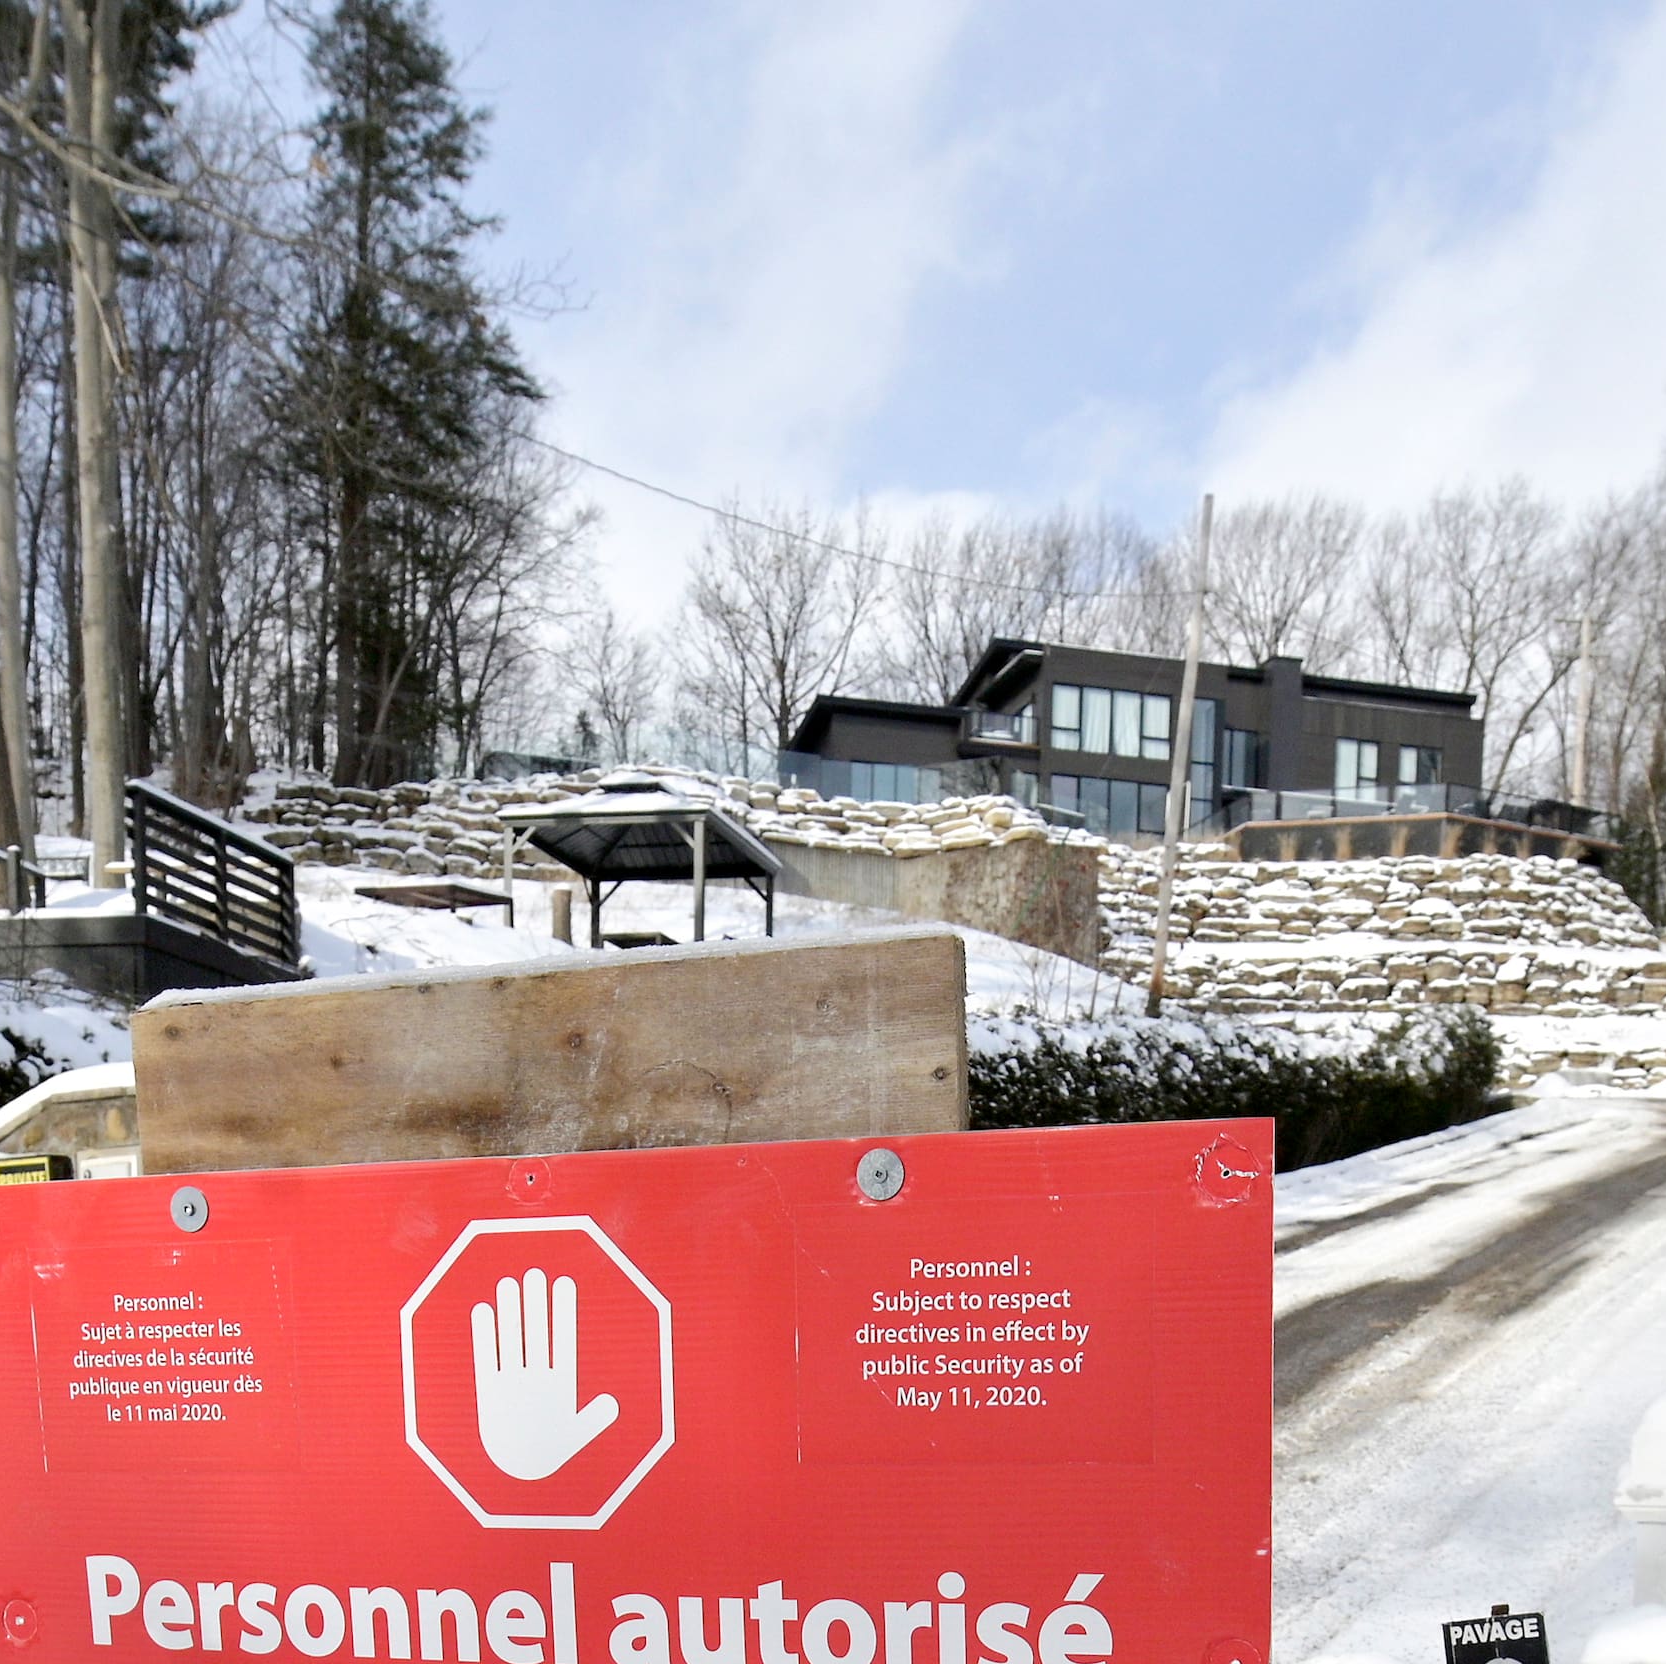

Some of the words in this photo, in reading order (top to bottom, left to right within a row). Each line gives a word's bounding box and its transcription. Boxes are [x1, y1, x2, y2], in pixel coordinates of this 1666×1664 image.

[910, 1254, 1019, 1279] Personnel
[113, 1290, 195, 1312] Personnel
[872, 1290, 954, 1316] Subject
[958, 1291, 983, 1310] to
[988, 1289, 1071, 1314] respect
[80, 1322, 122, 1345] Sujet
[125, 1321, 135, 1340] à
[138, 1321, 215, 1344] respecter
[218, 1318, 242, 1337] les
[855, 1322, 960, 1344] directives
[966, 1321, 986, 1342] in
[992, 1319, 1056, 1342] effect
[1061, 1319, 1090, 1346] by
[73, 1349, 143, 1369] direcives
[146, 1348, 167, 1367] de
[170, 1347, 185, 1367] la
[188, 1346, 254, 1366] sécurité
[862, 1354, 930, 1381] public
[934, 1353, 1025, 1380] Security
[1029, 1358, 1054, 1374] as
[1059, 1351, 1084, 1374] of
[69, 1376, 140, 1400] publique
[142, 1380, 164, 1395] en
[166, 1375, 230, 1399] vigueur
[233, 1374, 263, 1393] dès
[897, 1386, 943, 1412] May
[948, 1387, 980, 1409] 11,
[986, 1386, 1047, 1406] 2020.
[106, 1403, 122, 1422] le
[125, 1404, 142, 1422] 11
[147, 1403, 178, 1422] mai
[181, 1403, 227, 1422] 2020.
[1450, 1617, 1539, 1646] PAVAGE
